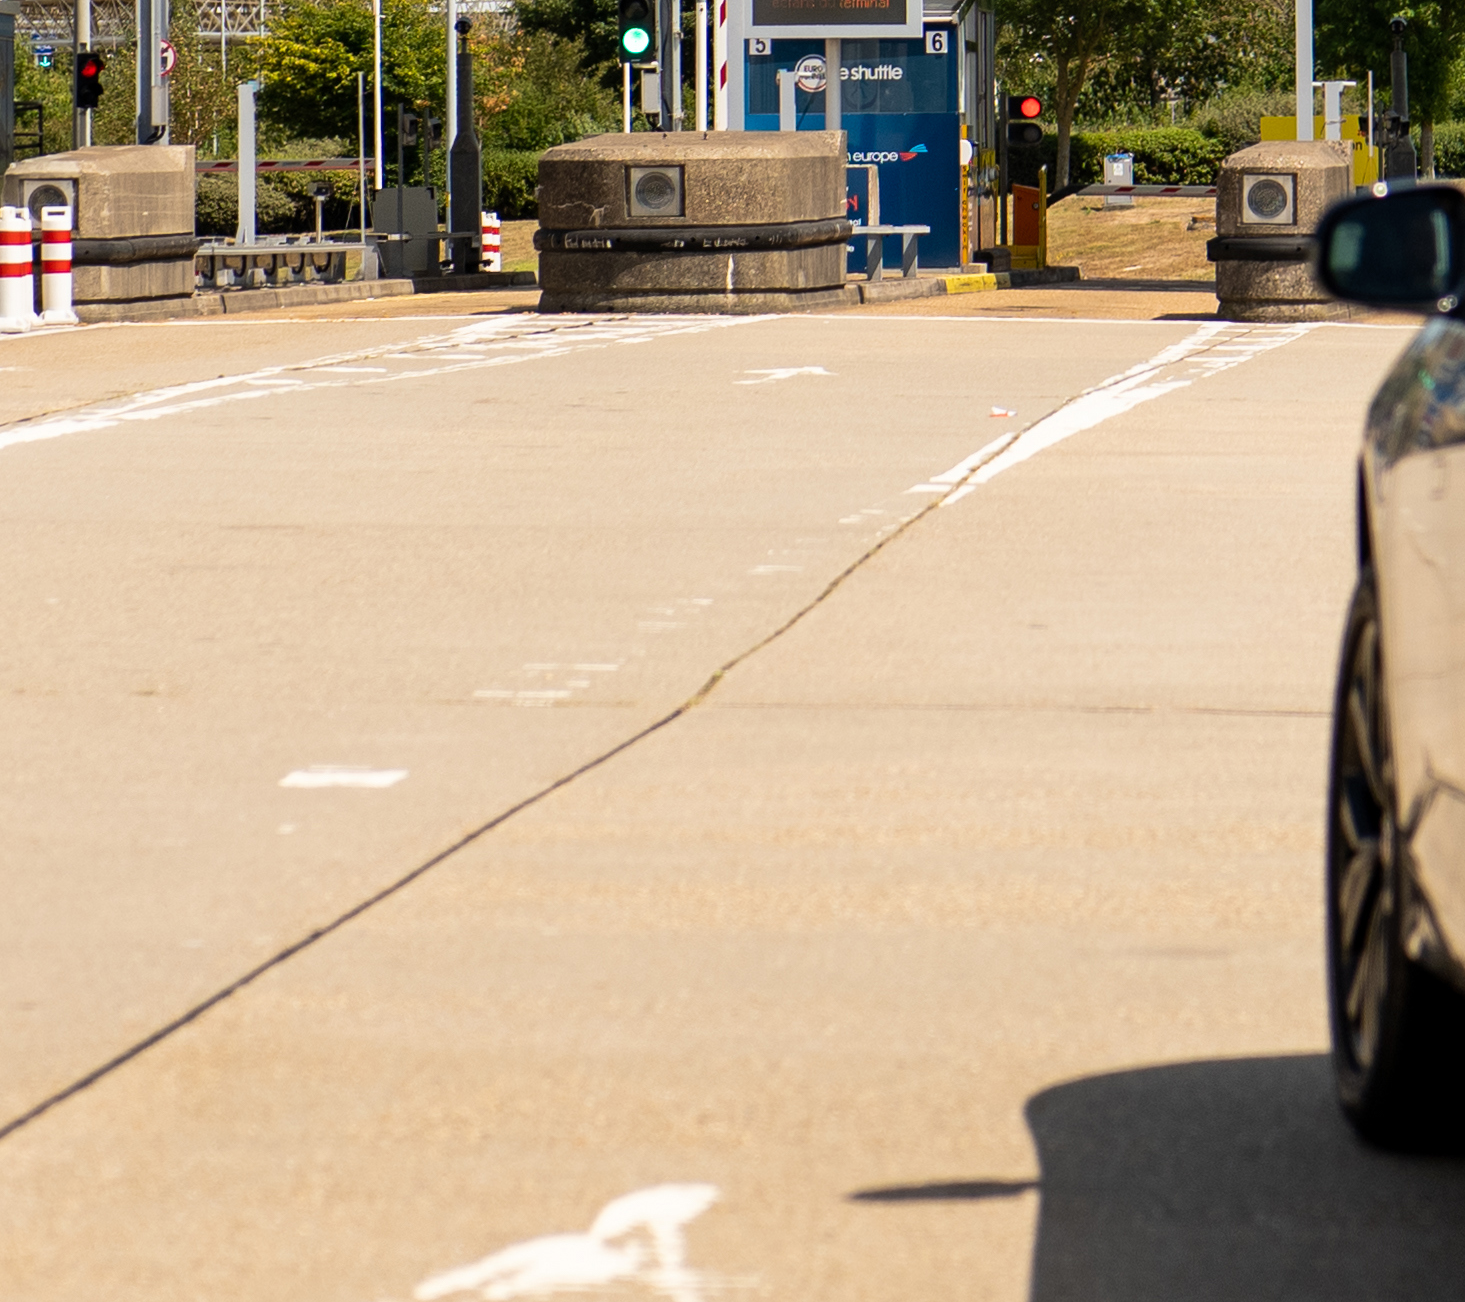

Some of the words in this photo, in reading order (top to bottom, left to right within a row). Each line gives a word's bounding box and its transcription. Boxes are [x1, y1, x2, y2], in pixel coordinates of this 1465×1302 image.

[755, 39, 766, 53] 5
[932, 33, 943, 52] 6
[850, 64, 903, 81] shuttle
[852, 150, 899, 164] europe
